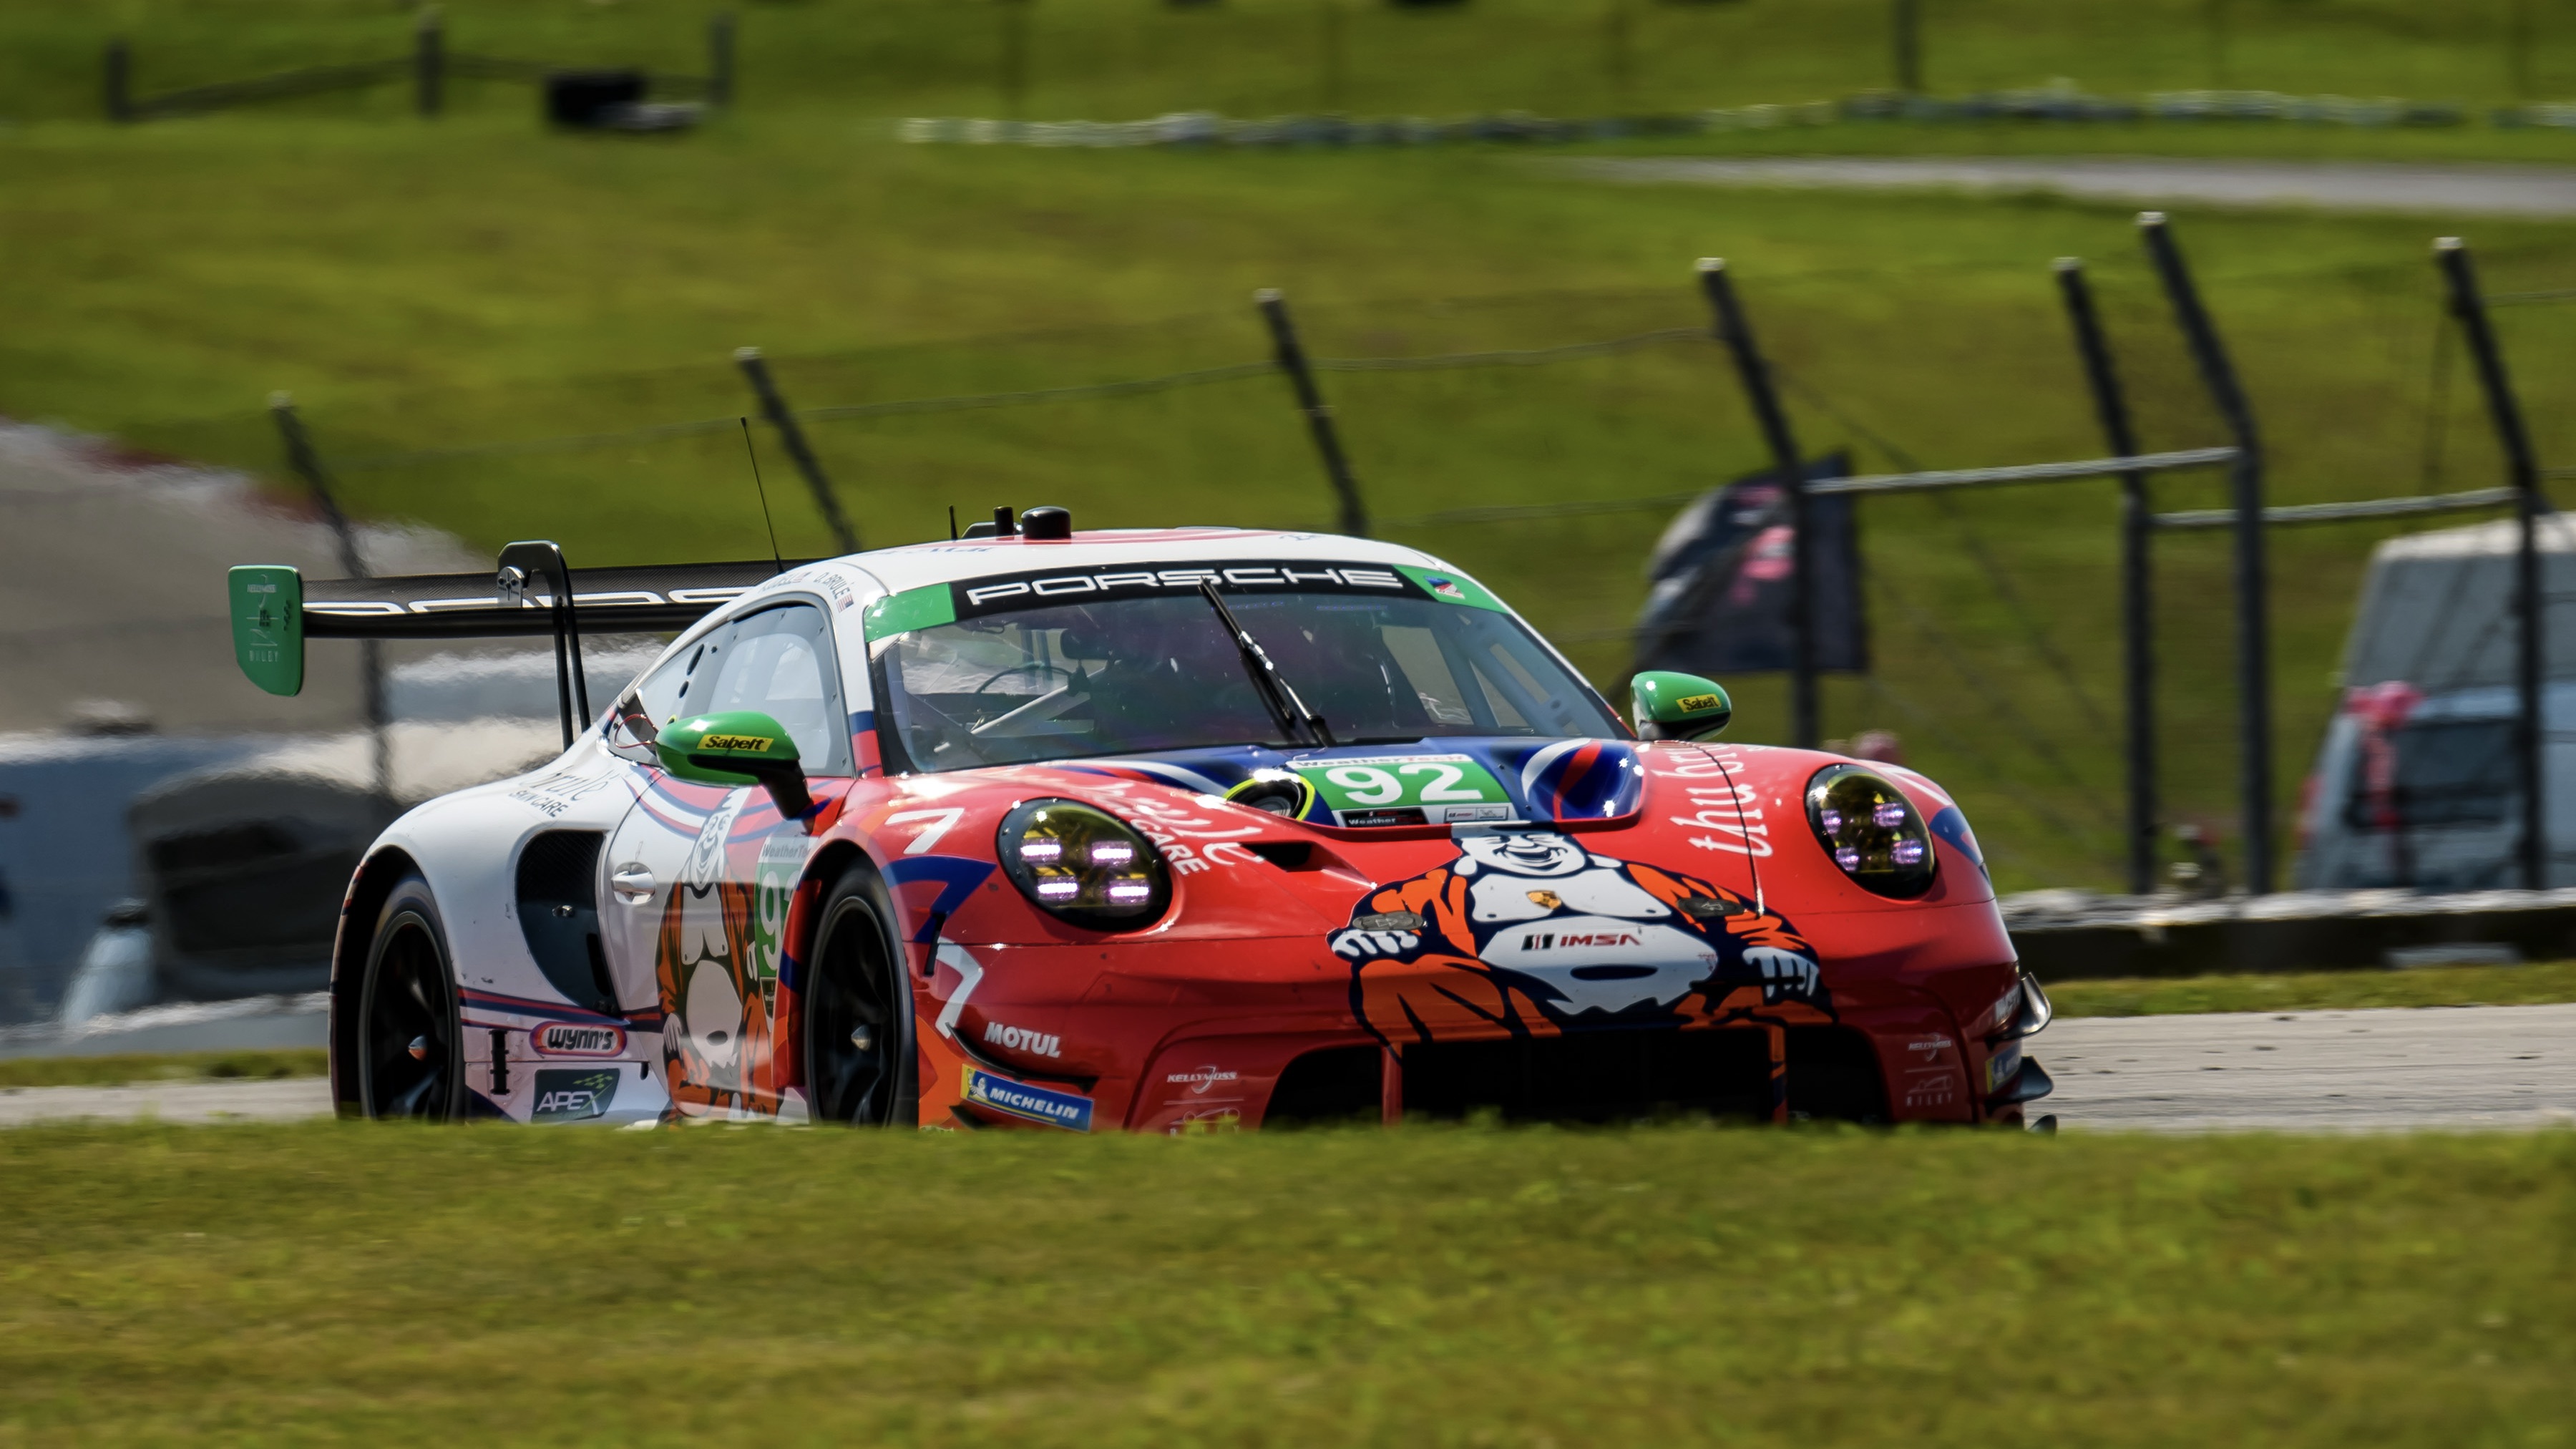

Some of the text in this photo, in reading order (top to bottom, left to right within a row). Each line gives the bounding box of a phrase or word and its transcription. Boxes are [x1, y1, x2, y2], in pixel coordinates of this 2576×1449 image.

[967, 567, 1404, 606] PORSCHE
[705, 736, 764, 750] Sabelt
[1325, 763, 1483, 804] 92
[762, 844, 811, 858] WeatherTe
[1559, 933, 1641, 947] IMSA
[984, 1022, 1061, 1058] MOTUL
[536, 1085, 607, 1116] APEX
[989, 1088, 1080, 1121] MICHELIN
